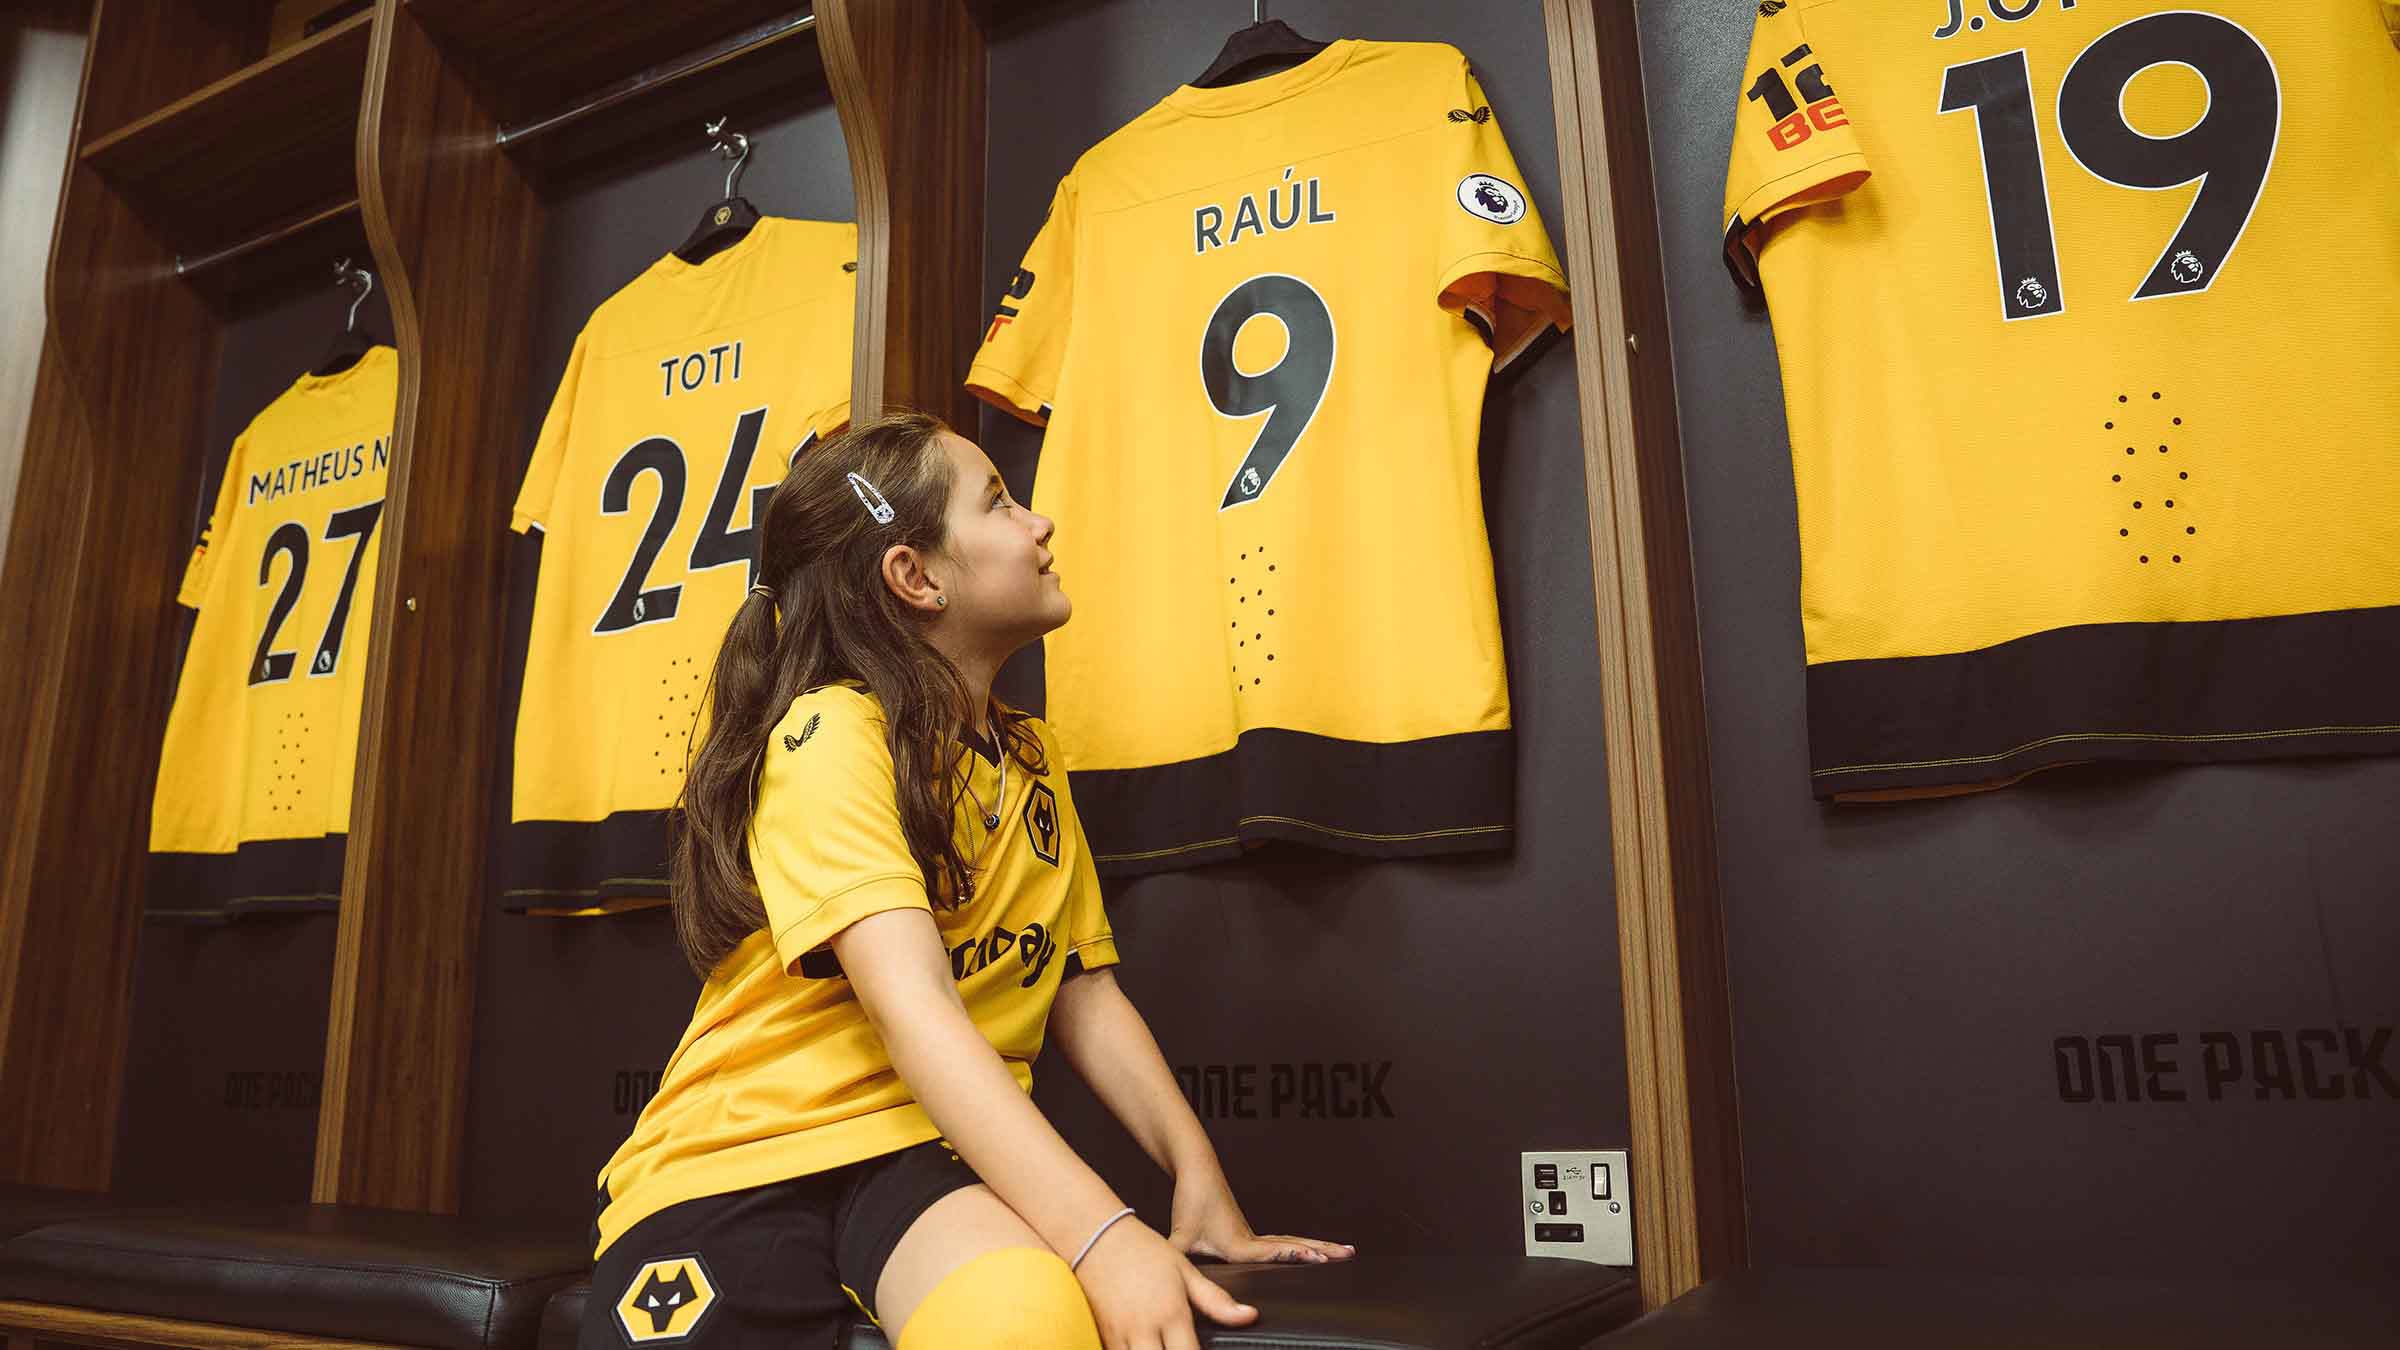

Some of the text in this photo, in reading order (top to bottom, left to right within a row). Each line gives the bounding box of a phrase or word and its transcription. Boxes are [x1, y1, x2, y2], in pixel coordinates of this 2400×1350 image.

[1936, 9, 2282, 322] 19
[1192, 166, 1336, 257] RAÚL
[661, 341, 744, 398] TOTI
[1200, 273, 1336, 512] 9
[247, 441, 366, 507] MATHEUS
[592, 405, 782, 636] 24
[247, 497, 386, 688] 27
[1270, 1062, 1396, 1119] PACK
[2054, 1027, 2400, 1104] ONE PACK
